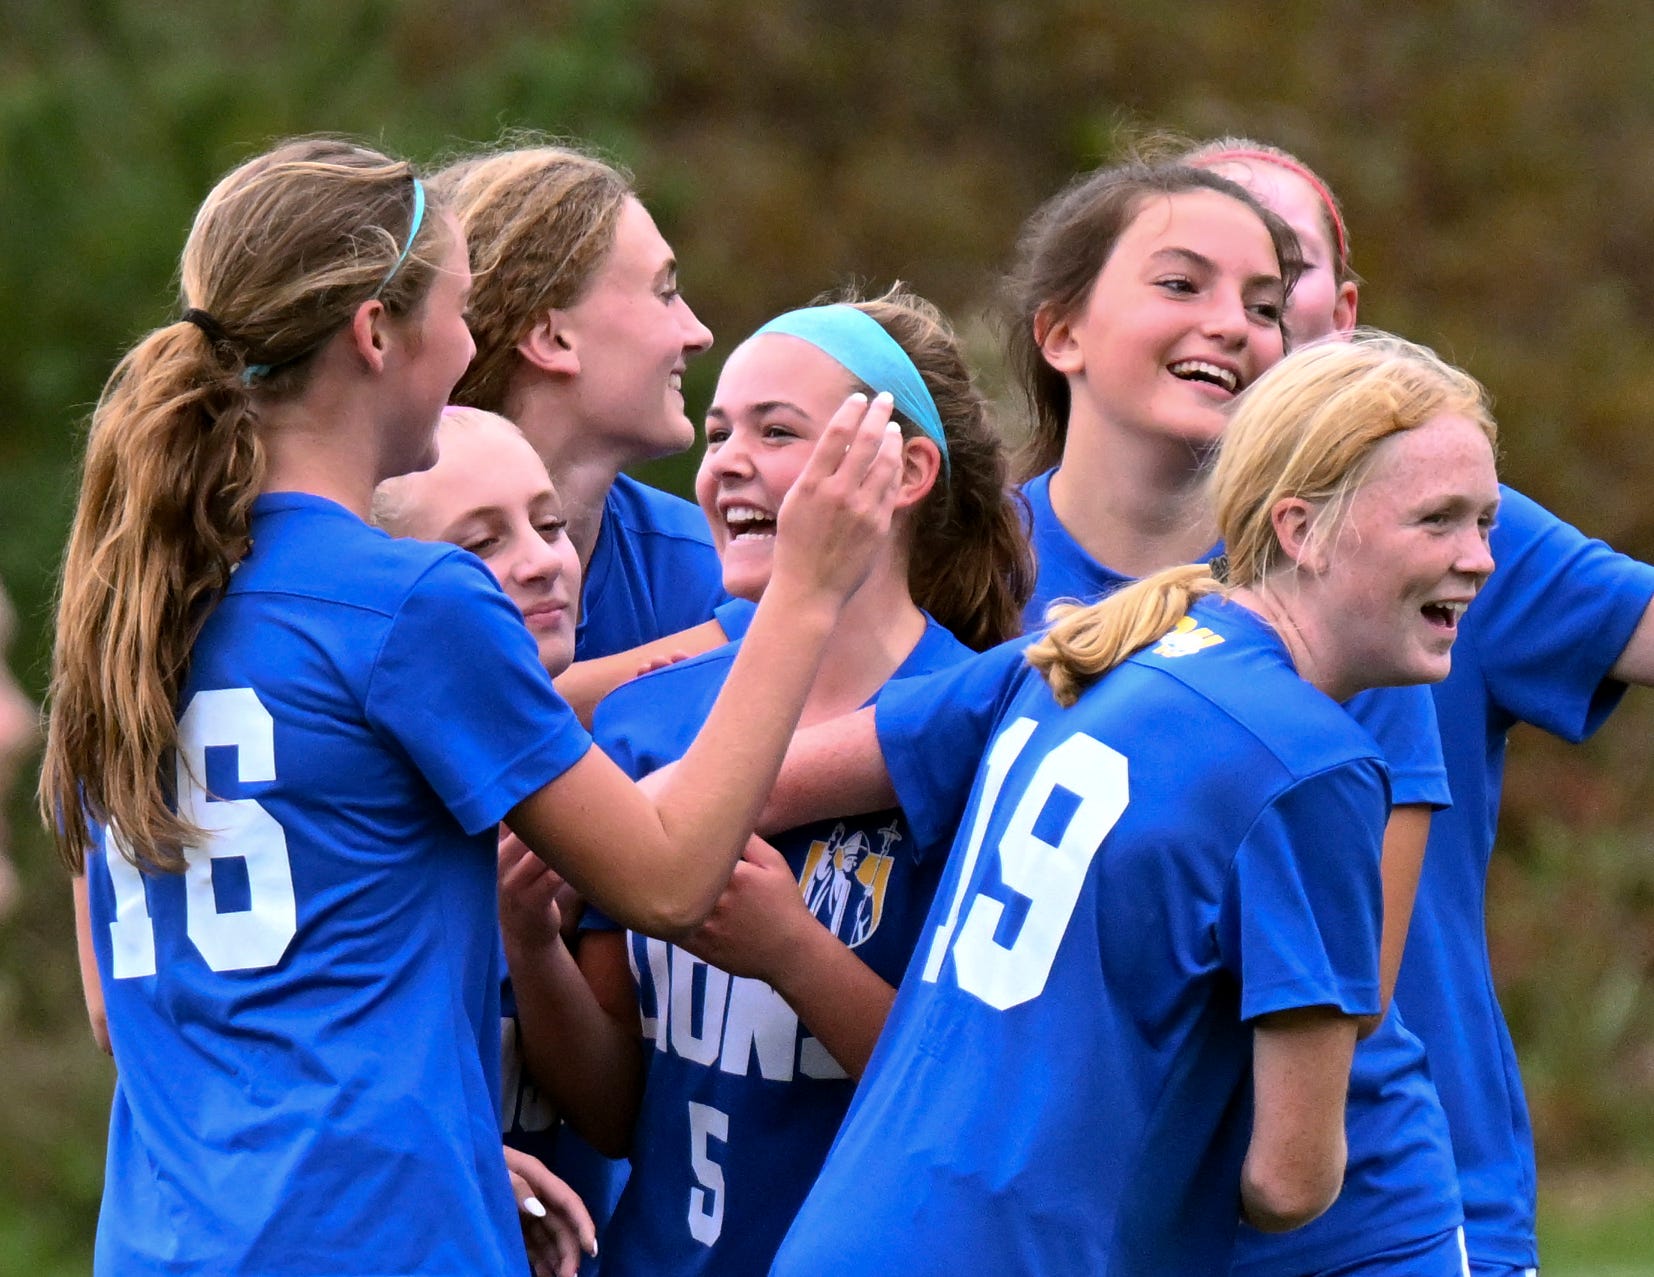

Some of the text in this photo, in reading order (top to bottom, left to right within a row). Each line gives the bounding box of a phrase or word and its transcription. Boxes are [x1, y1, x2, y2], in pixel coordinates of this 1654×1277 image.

[105, 688, 297, 979] 16
[922, 717, 1129, 1011] 19
[627, 929, 849, 1082] ION
[688, 1101, 729, 1247] 5
